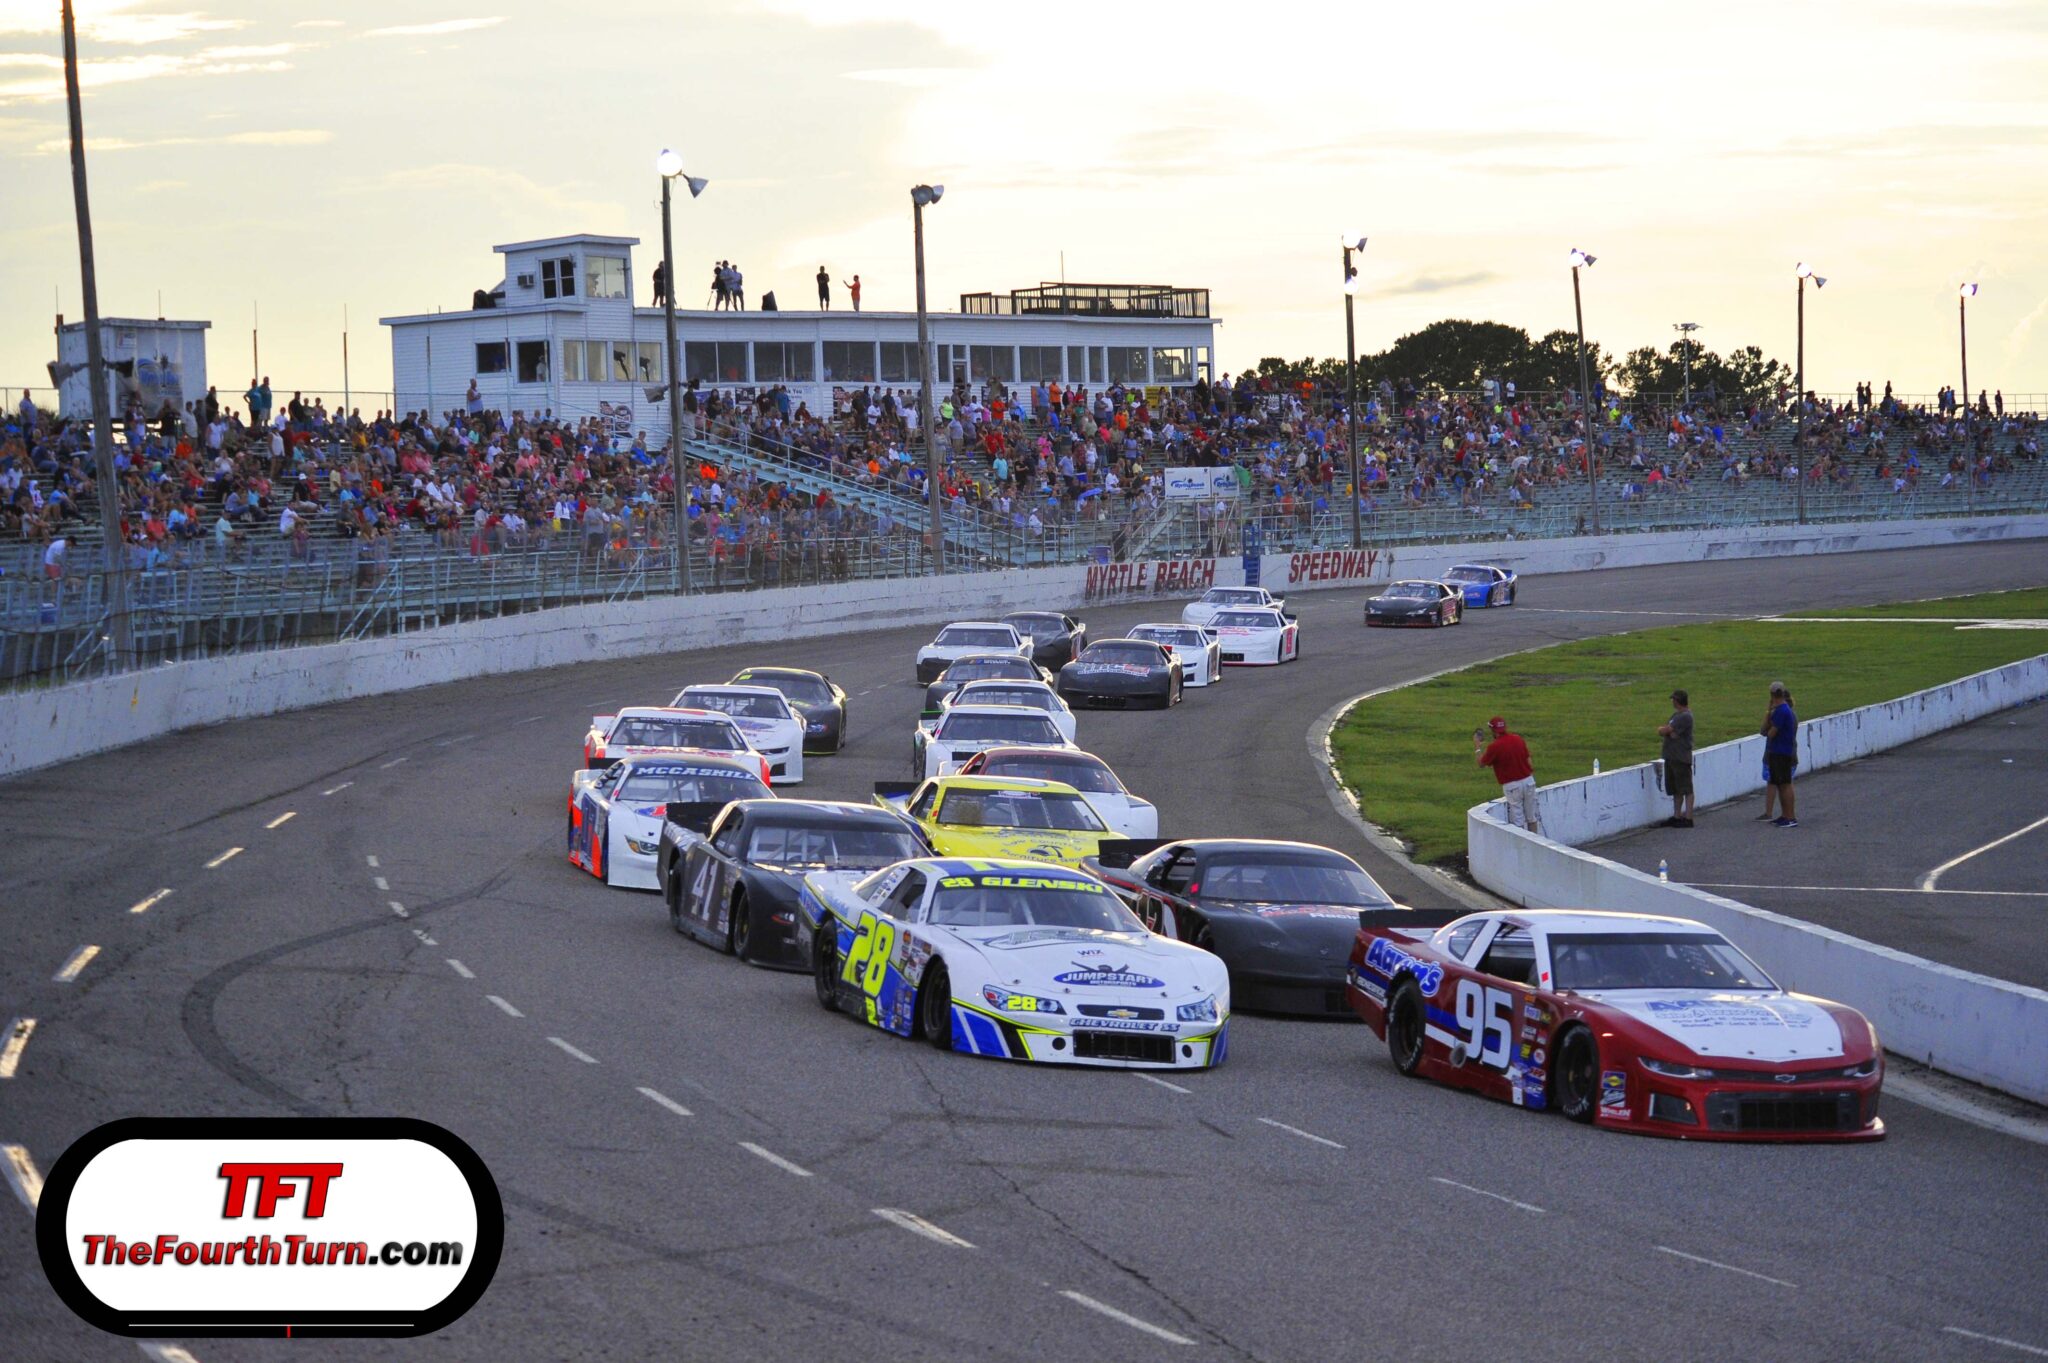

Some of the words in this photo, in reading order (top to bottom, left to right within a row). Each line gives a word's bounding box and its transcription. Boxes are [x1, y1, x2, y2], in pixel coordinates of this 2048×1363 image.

[1085, 562, 1148, 600] MYRTLE
[1154, 559, 1216, 593] BEACH
[1288, 550, 1378, 583] SPEEDWAY
[636, 766, 756, 781] MCCASKILL
[691, 855, 719, 921] 41
[940, 877, 975, 888] 28
[981, 876, 1104, 894] GLENSKI
[841, 909, 895, 998] 28
[1062, 971, 1156, 985] JUMPSTART
[1007, 995, 1038, 1012] 28
[1069, 1018, 1158, 1031] CHEVROLET
[1456, 978, 1513, 1069] 95
